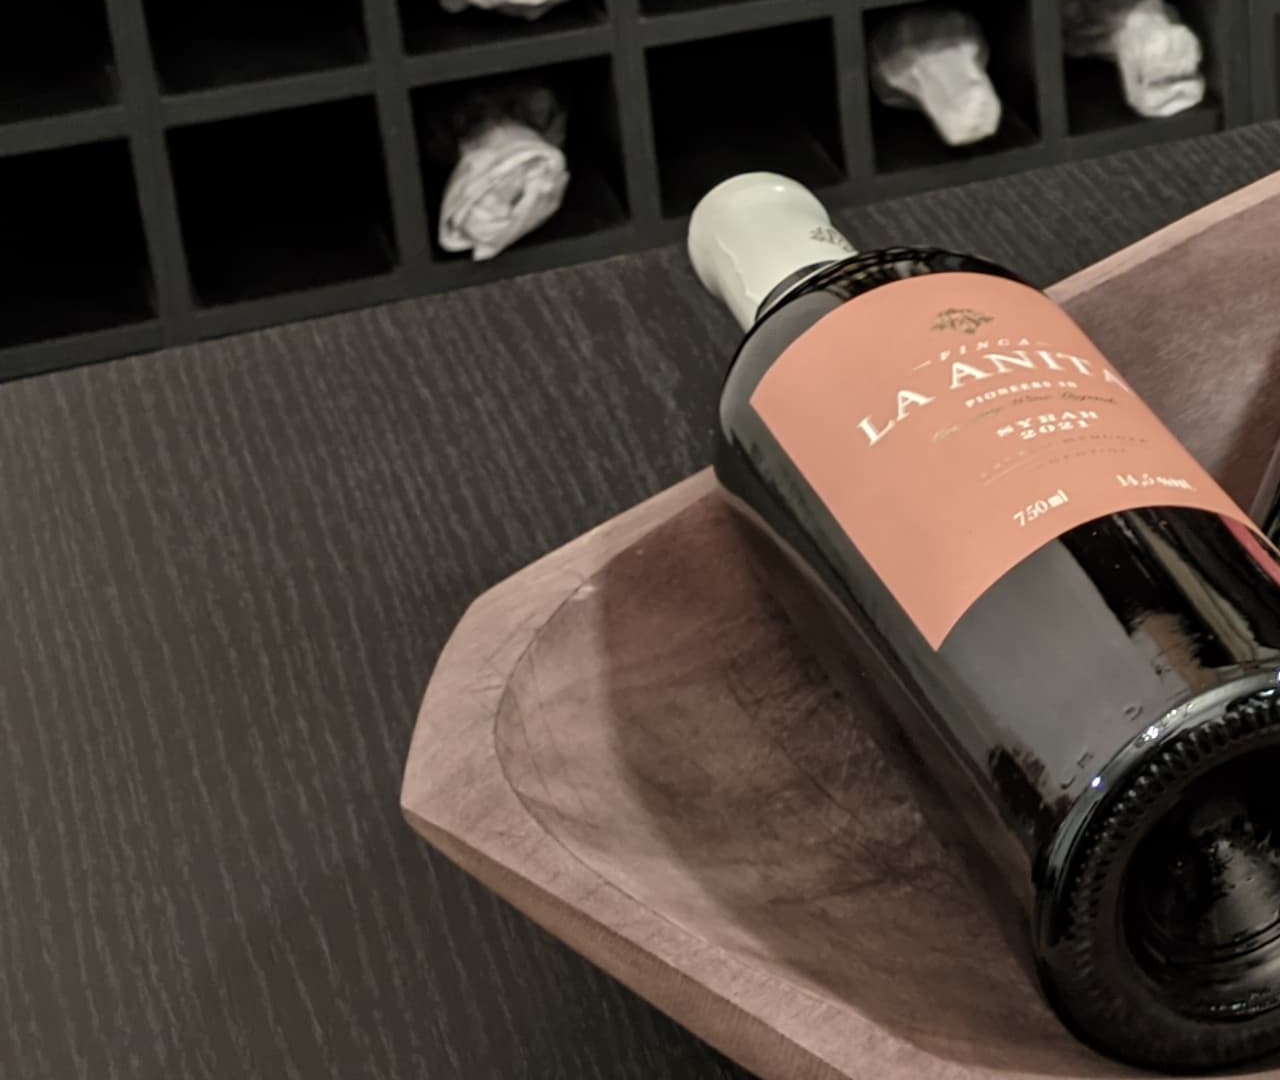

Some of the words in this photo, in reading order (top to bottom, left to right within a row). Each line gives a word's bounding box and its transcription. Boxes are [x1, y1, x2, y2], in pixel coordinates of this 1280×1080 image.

[940, 338, 1030, 360] FINCA
[965, 381, 1052, 408] PIONEERS
[857, 388, 936, 446] LA
[1013, 500, 1048, 528] 750
